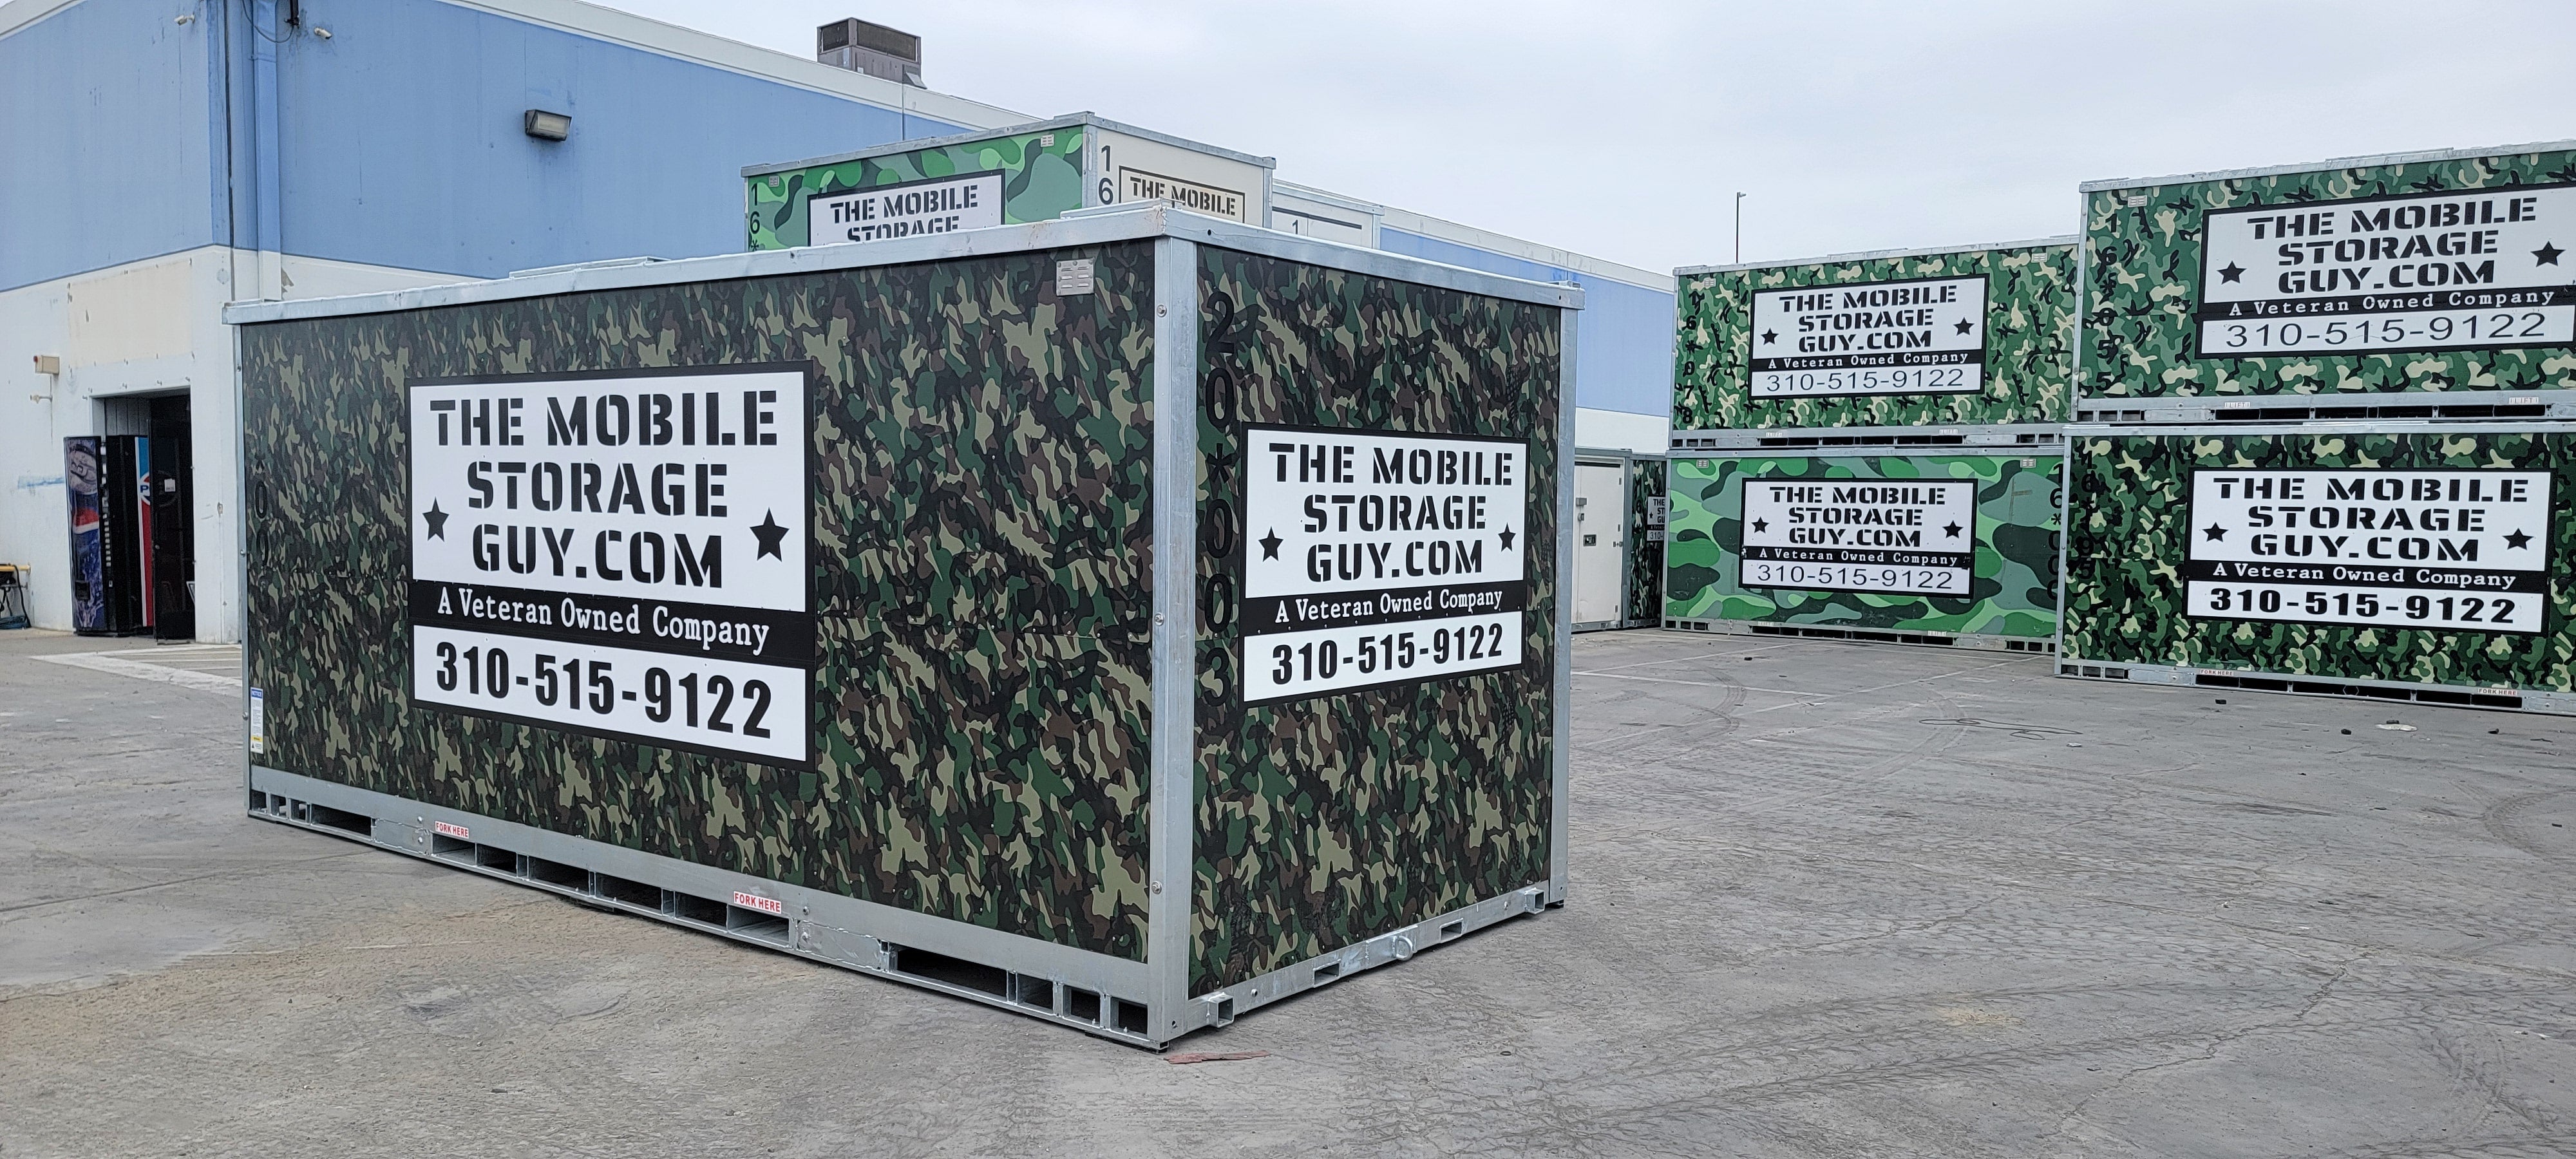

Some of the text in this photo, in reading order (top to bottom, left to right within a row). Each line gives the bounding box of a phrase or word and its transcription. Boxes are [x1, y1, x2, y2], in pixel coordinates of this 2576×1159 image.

[830, 185, 978, 223] THE MOBILE
[1130, 176, 1235, 216] THE MOBILE
[848, 216, 960, 241] STORAGE
[2248, 198, 2537, 240] THE MOBILE
[2278, 229, 2498, 267] STORAGE
[2278, 260, 2494, 293] GUY.COM
[1779, 285, 1956, 312] THE MOBILE
[2230, 292, 2554, 316] A Veteran Owned Company
[1799, 308, 1933, 332] STORAGE
[2226, 313, 2544, 347] 310-515-9122
[1799, 328, 1931, 352] GUY.COM
[1768, 353, 1967, 368] A Veteran Owned Company
[1767, 369, 1963, 391] 310-515-9122
[430, 391, 777, 446] THE MOBILE
[1269, 443, 1512, 485] THE MOBILE
[468, 462, 727, 517] STORAGE
[1770, 487, 1946, 505] THE MOBILE
[2213, 478, 2528, 502] THE MOBILE
[1304, 495, 1486, 532] STORAGE
[1789, 507, 1922, 525] STORAGE
[2249, 506, 2485, 531] STORAGE
[1790, 528, 1920, 547] GUY.COM
[2251, 534, 2478, 561] GUY.COM
[473, 524, 721, 588] GUY.COM
[1307, 540, 1482, 582] GUY.COM
[1759, 548, 1957, 566] A Veteran Owned Company
[1758, 565, 1952, 589] 310-515-9122
[2213, 563, 2515, 590] A Veteran Owned Company
[1275, 589, 1502, 623] A Veteran Owned Company
[2211, 589, 2515, 623] 310-515-9122
[438, 587, 769, 655] A Veteran Owned Company
[1273, 623, 1502, 684] 310-515-9122
[437, 642, 771, 739] 310-515-9122
[436, 822, 468, 837] FORK HERE
[735, 893, 781, 912] FORK HERE
